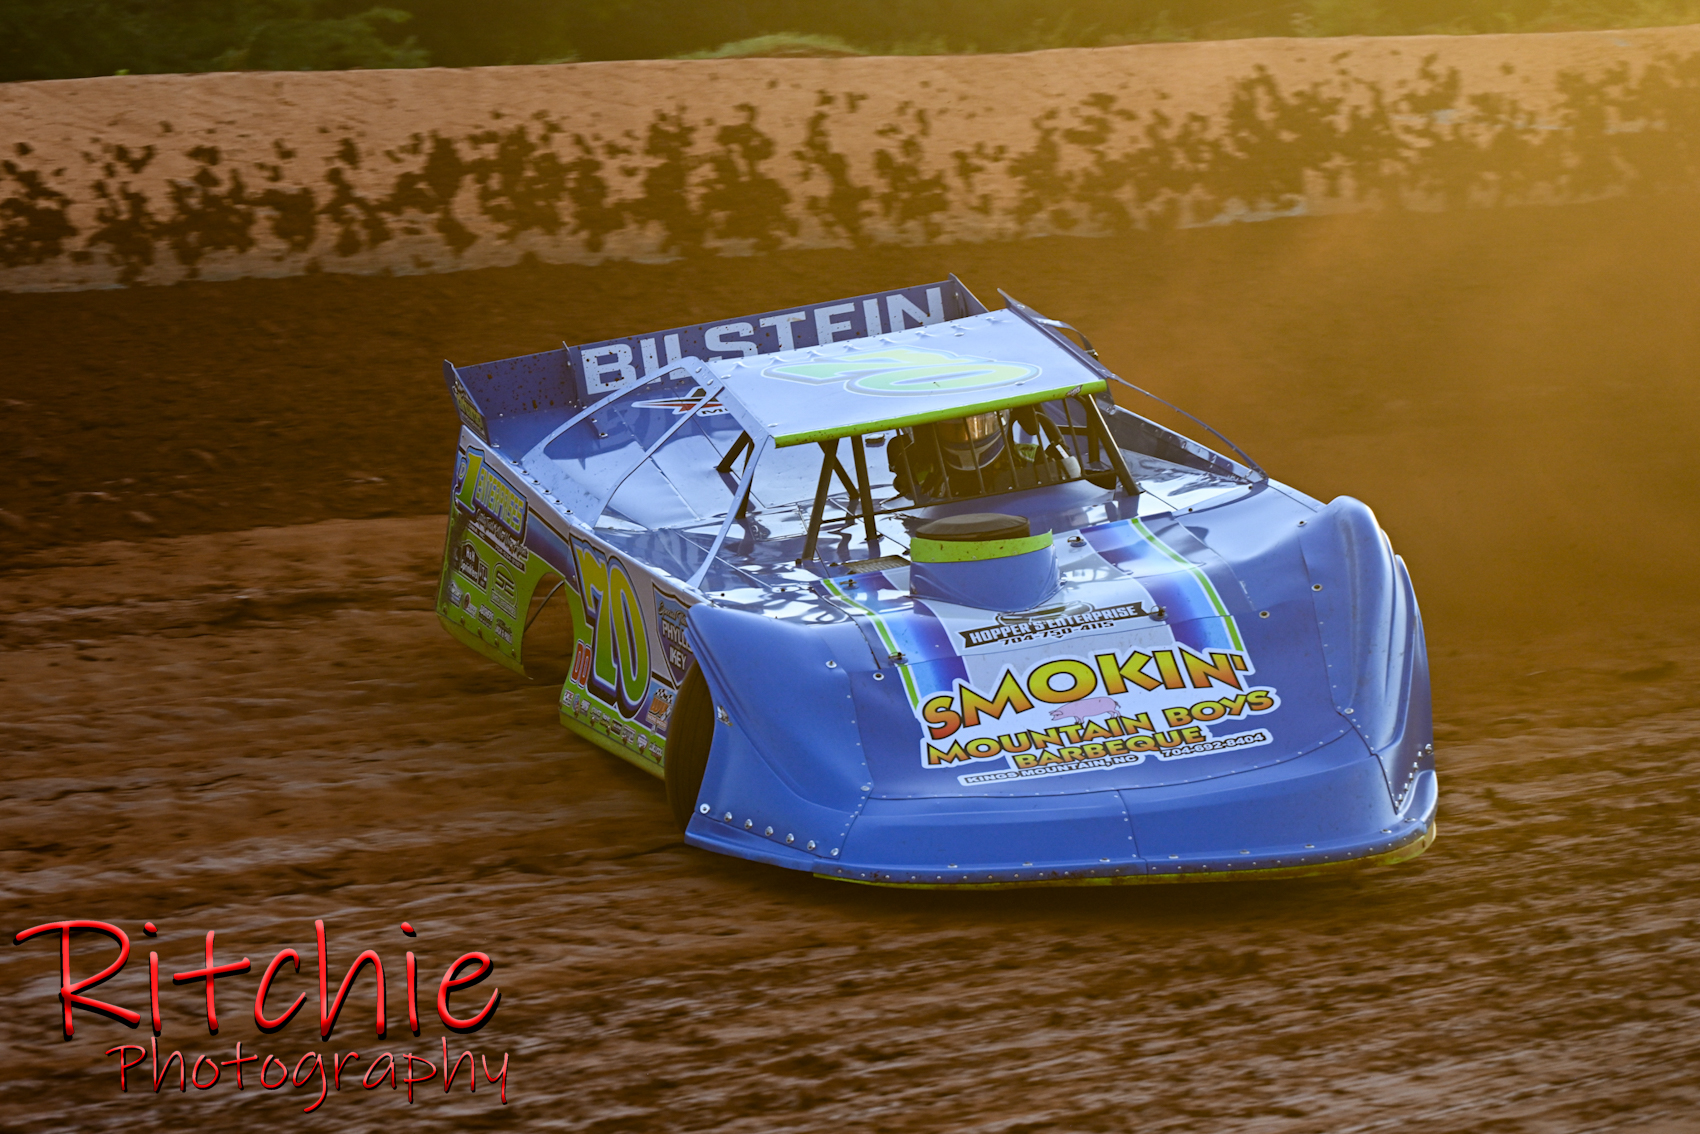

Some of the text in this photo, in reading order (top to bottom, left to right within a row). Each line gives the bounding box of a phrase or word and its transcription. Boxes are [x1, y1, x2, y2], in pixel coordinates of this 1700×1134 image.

[581, 286, 946, 395] BILSTEIN
[573, 540, 650, 712] 70
[969, 605, 1138, 644] HOPPER'S ENTERPRISE
[922, 647, 1249, 740] SMOKIN'
[926, 690, 1275, 766] MOUNTAIN BOYS
[1011, 726, 1206, 770] BARBEQUE
[1161, 733, 1266, 758] 704-692-8404
[964, 769, 1018, 784] KINGS
[1114, 753, 1140, 767] NC
